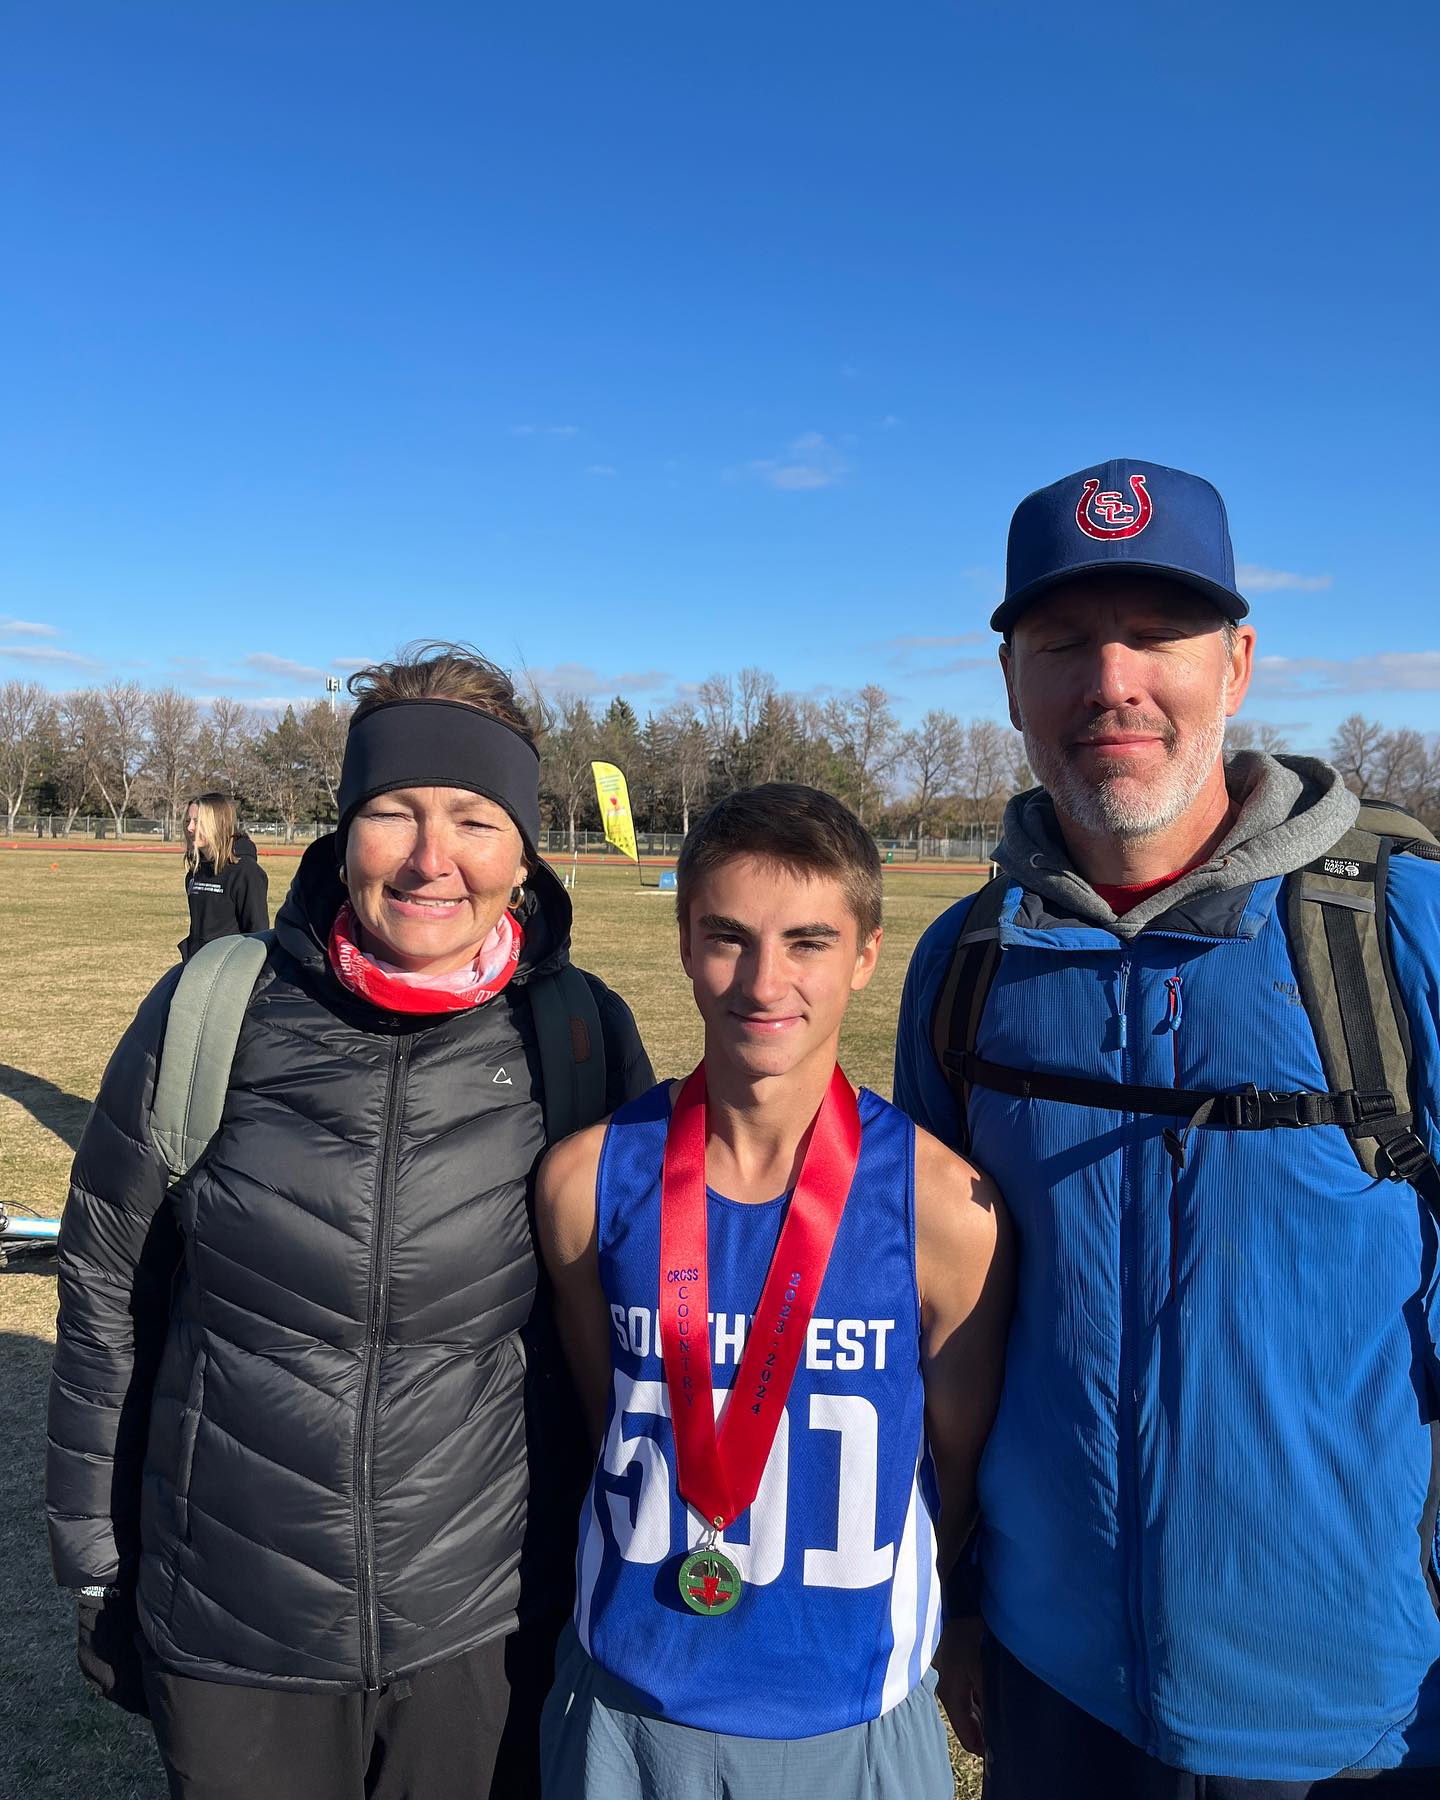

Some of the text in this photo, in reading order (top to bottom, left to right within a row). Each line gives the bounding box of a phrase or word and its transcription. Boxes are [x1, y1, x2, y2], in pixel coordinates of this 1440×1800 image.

[1095, 491, 1133, 523] SC
[1325, 858, 1360, 867] MOUNTAIN
[1324, 867, 1345, 876] WEAR
[667, 1268, 699, 1283] CROSS
[677, 1286, 695, 1409] COUNTRY
